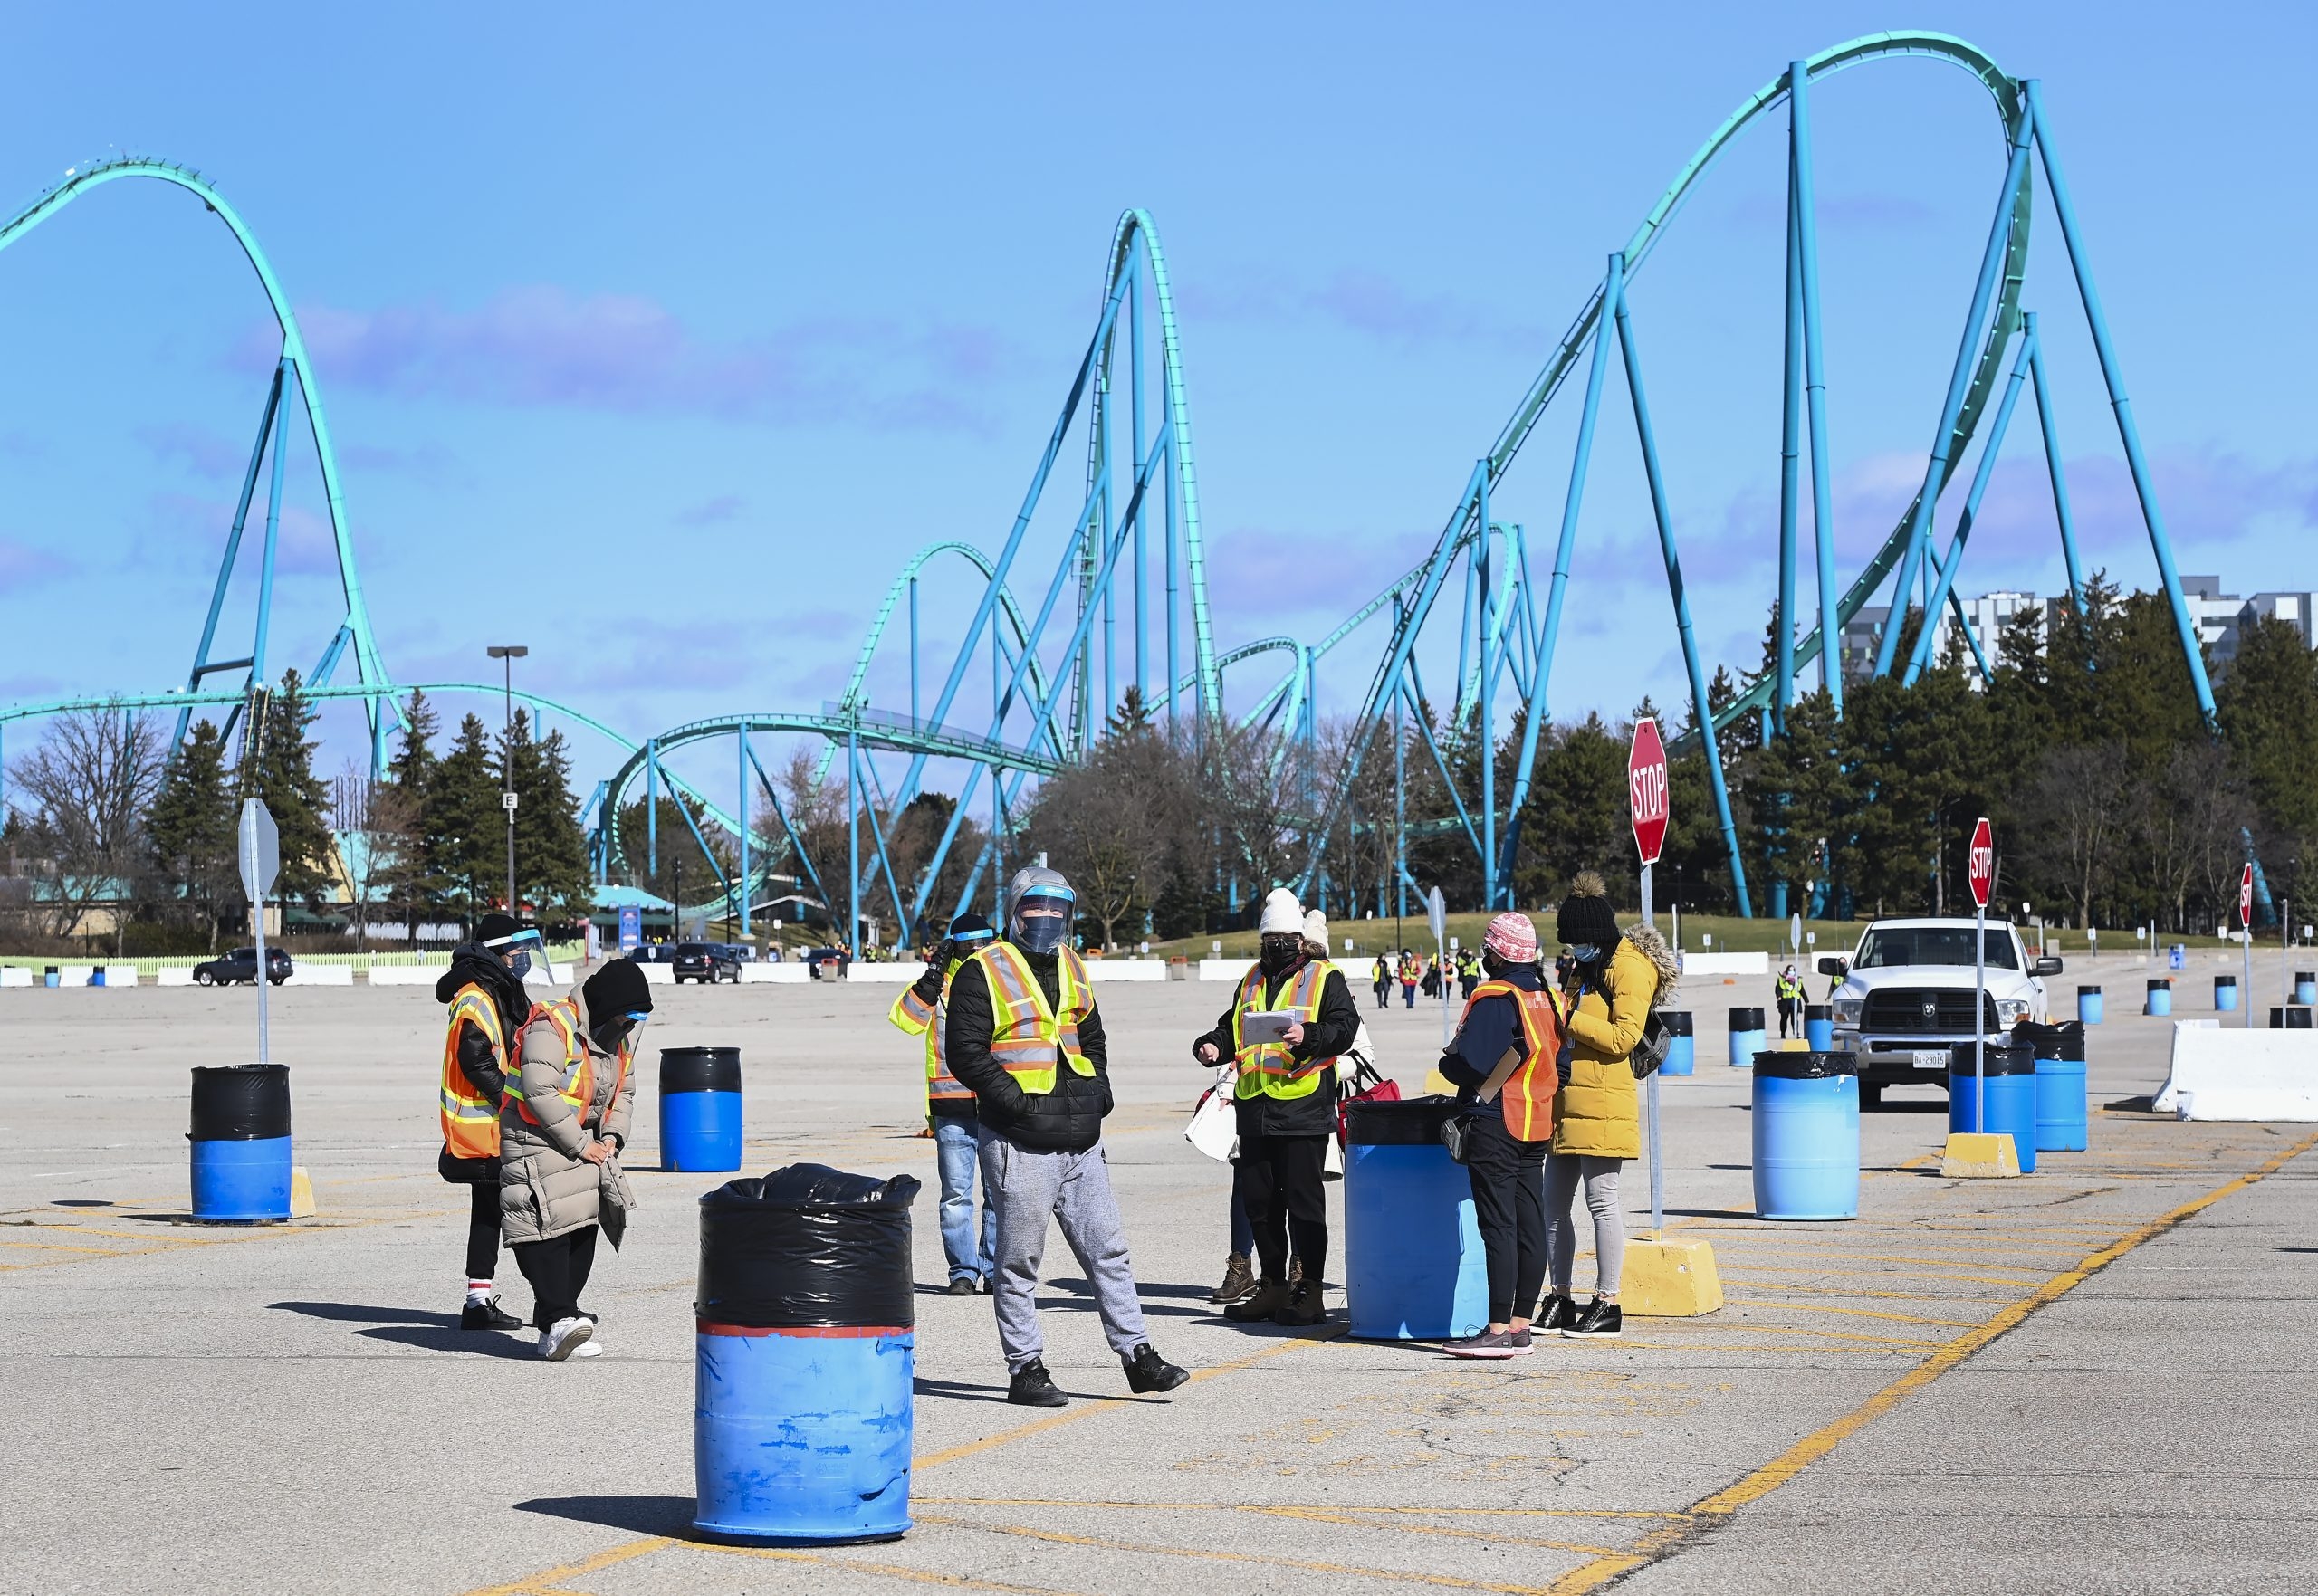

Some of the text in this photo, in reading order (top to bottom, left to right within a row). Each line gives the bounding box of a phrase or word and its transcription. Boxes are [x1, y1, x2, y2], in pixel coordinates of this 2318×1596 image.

[506, 796, 513, 806] E
[1633, 762, 1665, 820] STOP
[1971, 846, 1991, 879] STOP
